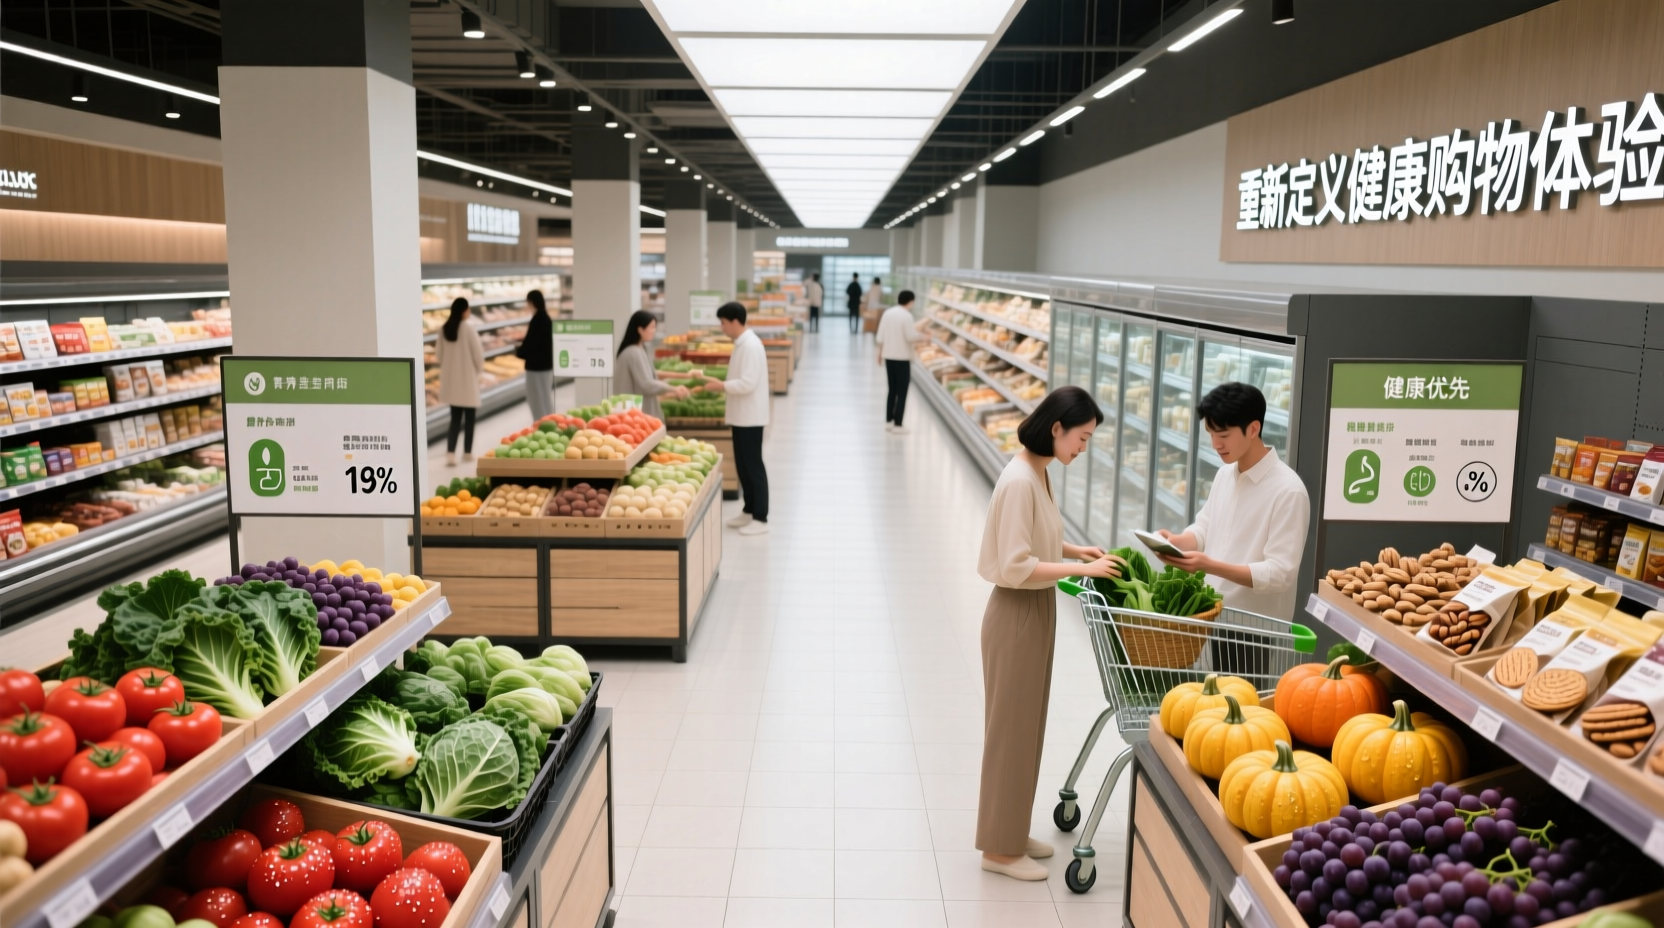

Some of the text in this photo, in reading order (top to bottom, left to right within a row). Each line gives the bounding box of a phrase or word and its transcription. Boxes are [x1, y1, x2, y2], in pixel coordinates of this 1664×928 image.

[1236, 92, 1664, 230] 重新定义健康购物体验
[1383, 375, 1470, 400] 健康优先
[345, 466, 398, 494] 19%
